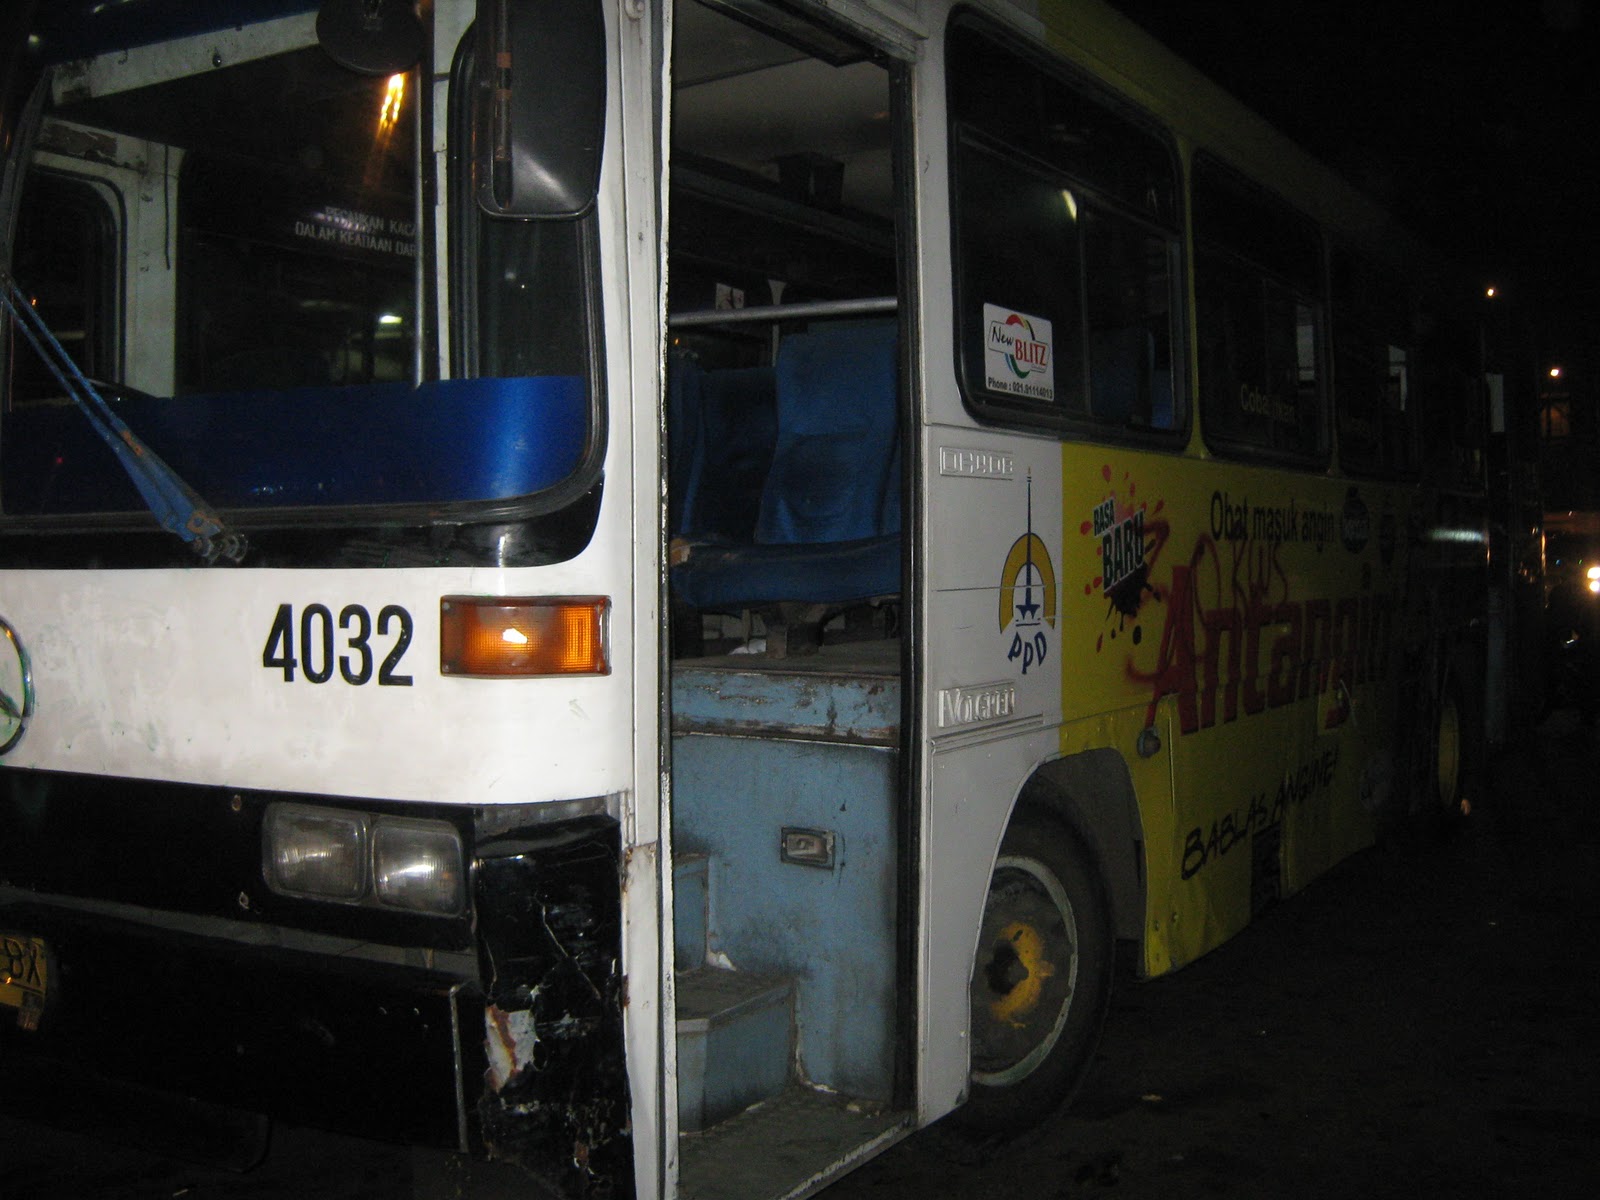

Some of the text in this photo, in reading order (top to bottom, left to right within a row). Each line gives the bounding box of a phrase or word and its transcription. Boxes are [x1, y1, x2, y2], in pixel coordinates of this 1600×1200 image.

[294, 221, 336, 241] DALAM
[339, 231, 393, 253] KEADAAN
[991, 326, 1046, 367] New BLITZ
[1093, 499, 1115, 537] RASA
[1102, 510, 1145, 590] BARU
[1210, 491, 1249, 541] Obat
[1252, 500, 1298, 542] masuk
[1301, 503, 1336, 552] angin
[263, 603, 413, 686] 4032
[1144, 562, 1392, 736] Antangin
[1181, 791, 1269, 881] BABLAS
